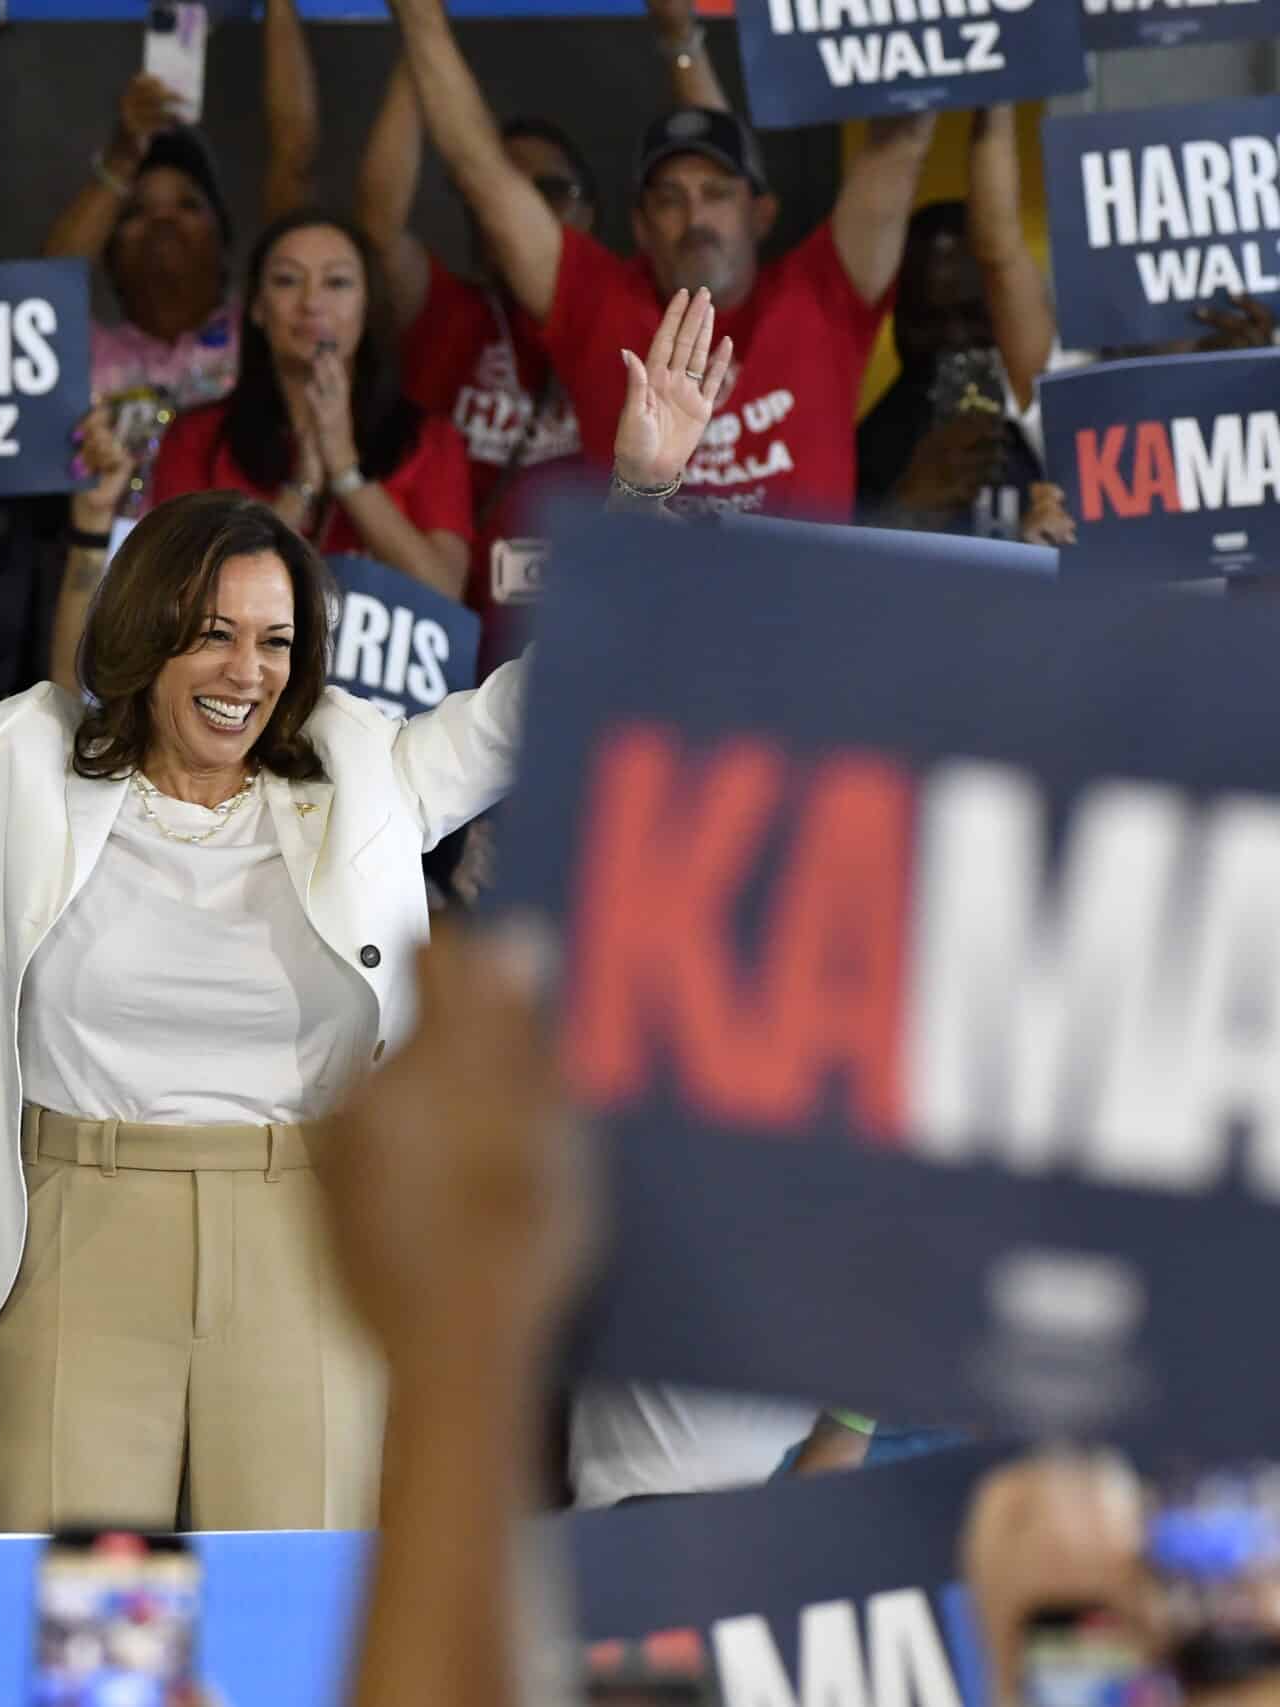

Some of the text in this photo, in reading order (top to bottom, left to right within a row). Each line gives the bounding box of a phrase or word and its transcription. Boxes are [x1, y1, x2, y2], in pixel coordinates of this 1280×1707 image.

[818, 21, 1006, 87] WALZ
[1081, 132, 1280, 248] HARR
[1135, 241, 1280, 304] WAL
[1075, 410, 1280, 523] KAMA
[563, 715, 1280, 1200] KAMA
